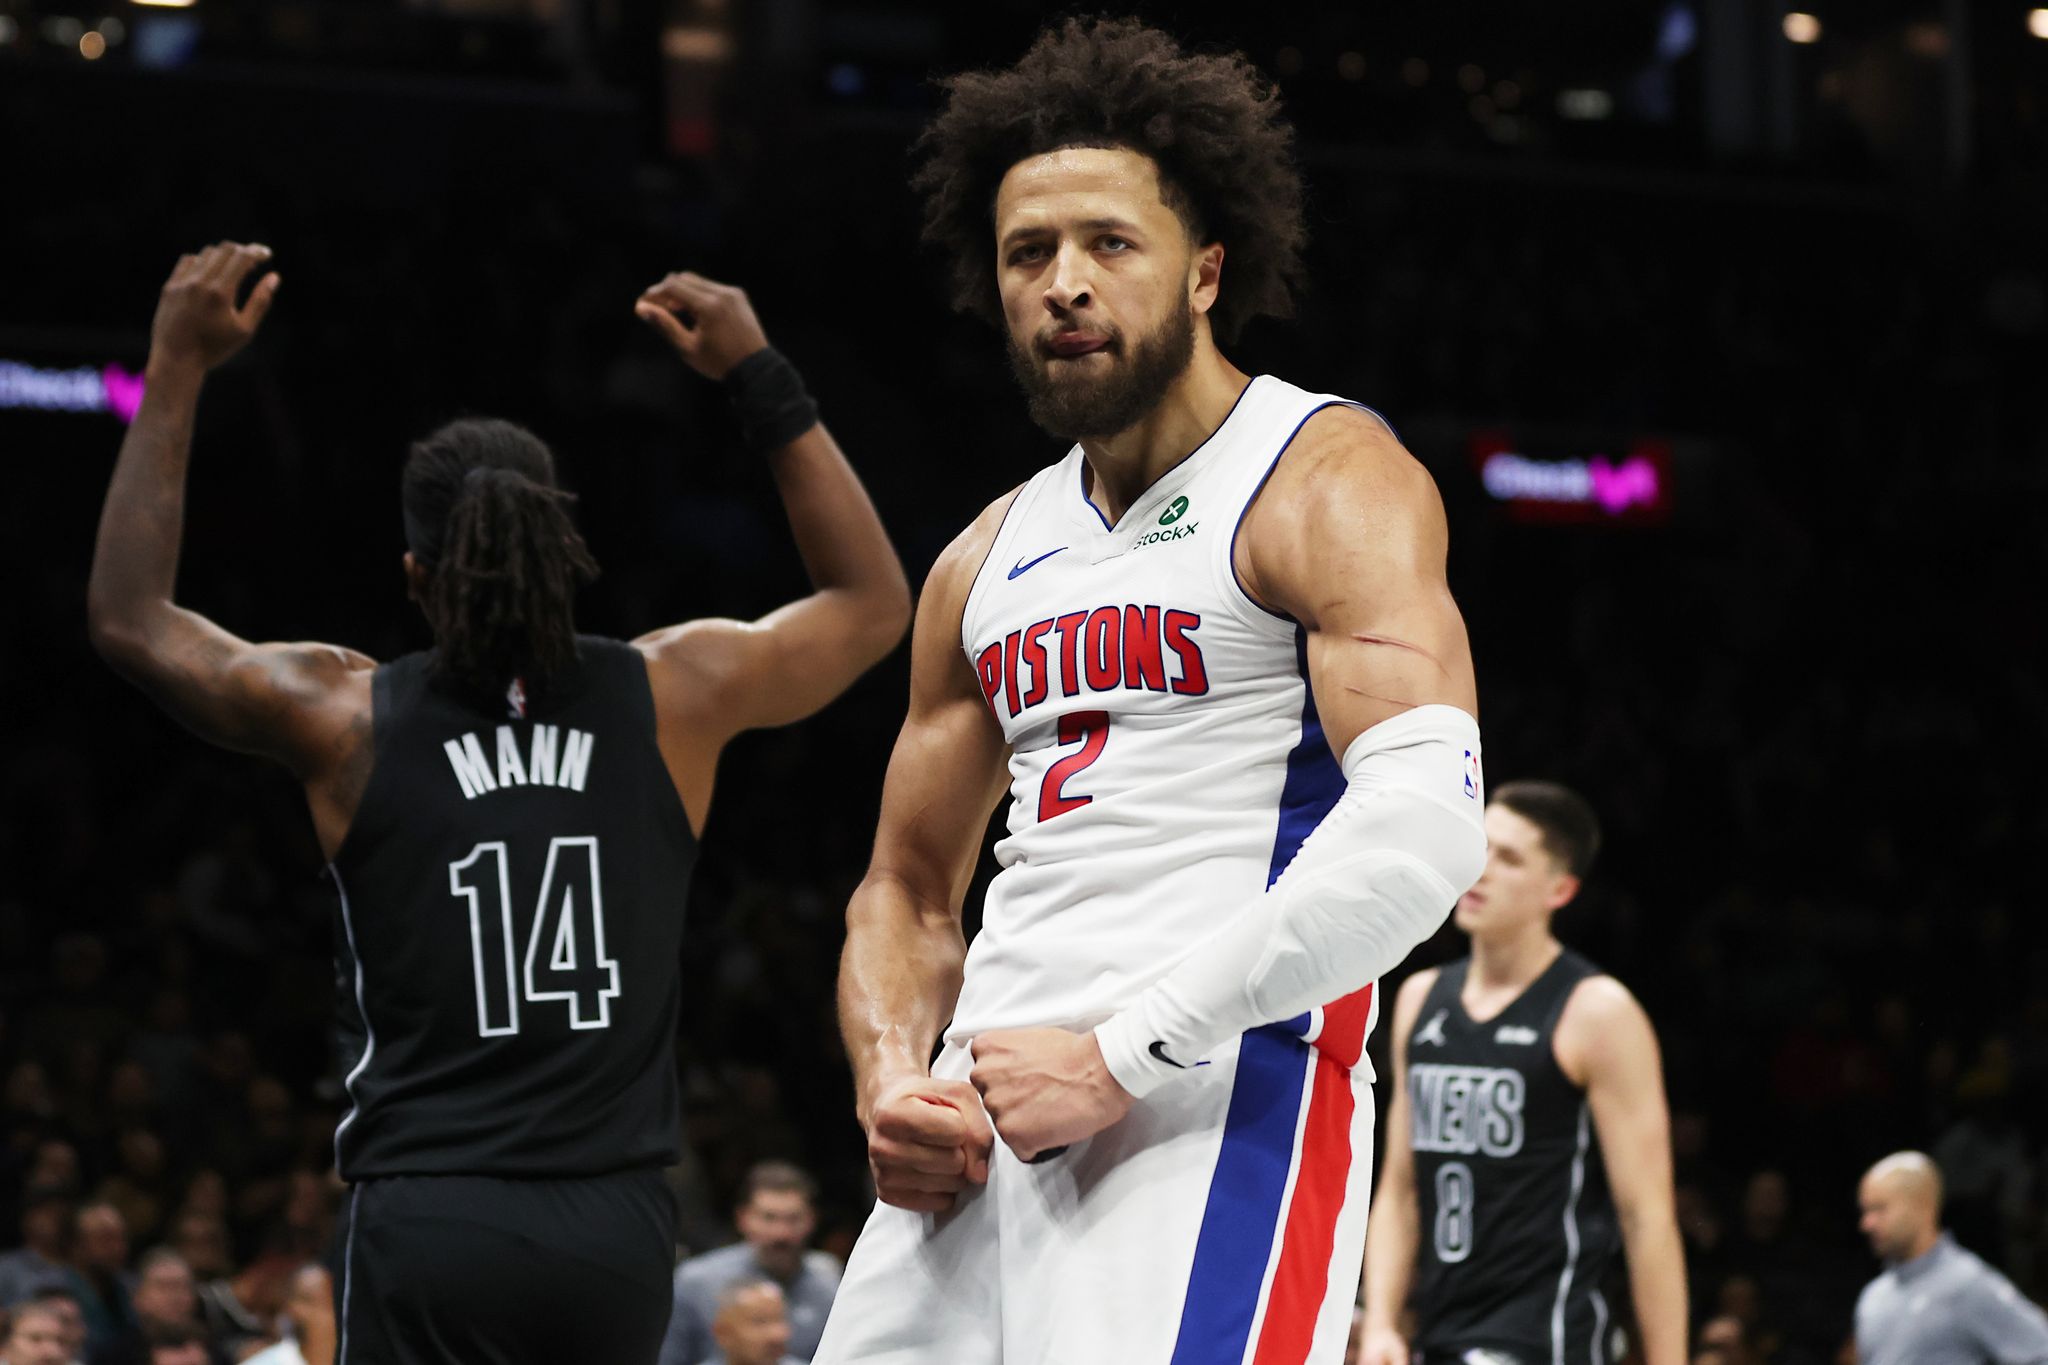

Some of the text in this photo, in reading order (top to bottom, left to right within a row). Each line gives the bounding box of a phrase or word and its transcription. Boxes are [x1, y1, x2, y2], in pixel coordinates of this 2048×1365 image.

[977, 604, 1209, 724] PISTONS
[443, 723, 594, 799] MANN
[1038, 710, 1110, 823] 2
[449, 836, 620, 1037] 14
[1408, 1063, 1525, 1158] NETS
[1434, 1161, 1474, 1263] 8
